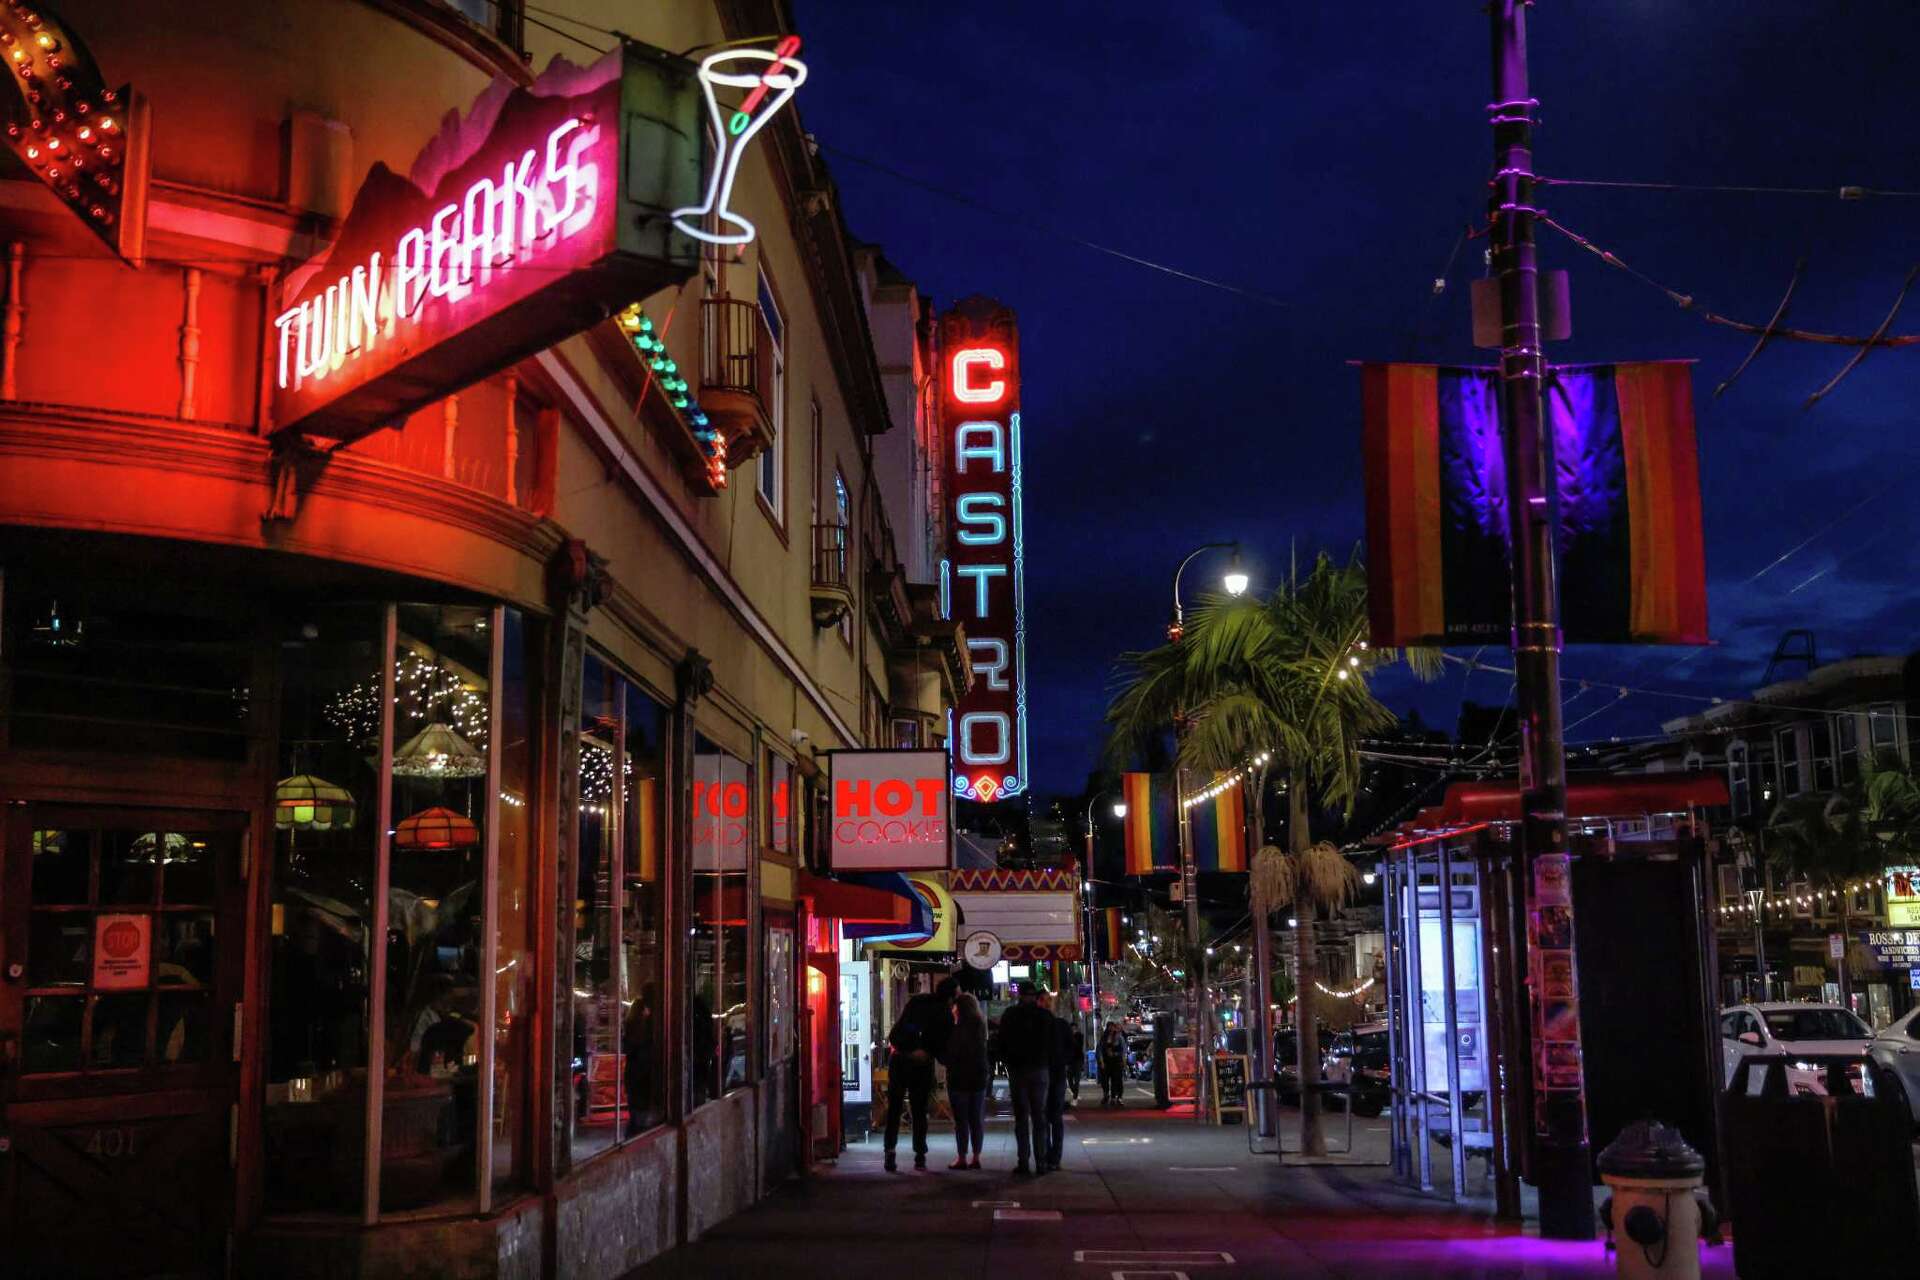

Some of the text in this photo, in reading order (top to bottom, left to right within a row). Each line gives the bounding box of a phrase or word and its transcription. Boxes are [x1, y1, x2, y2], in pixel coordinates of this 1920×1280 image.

[275, 117, 592, 389] TWIN PEAKS
[952, 348, 1011, 766] CASTRO
[836, 779, 945, 818] HOT
[835, 819, 946, 845] COOKIE
[1905, 931, 1920, 946] DE
